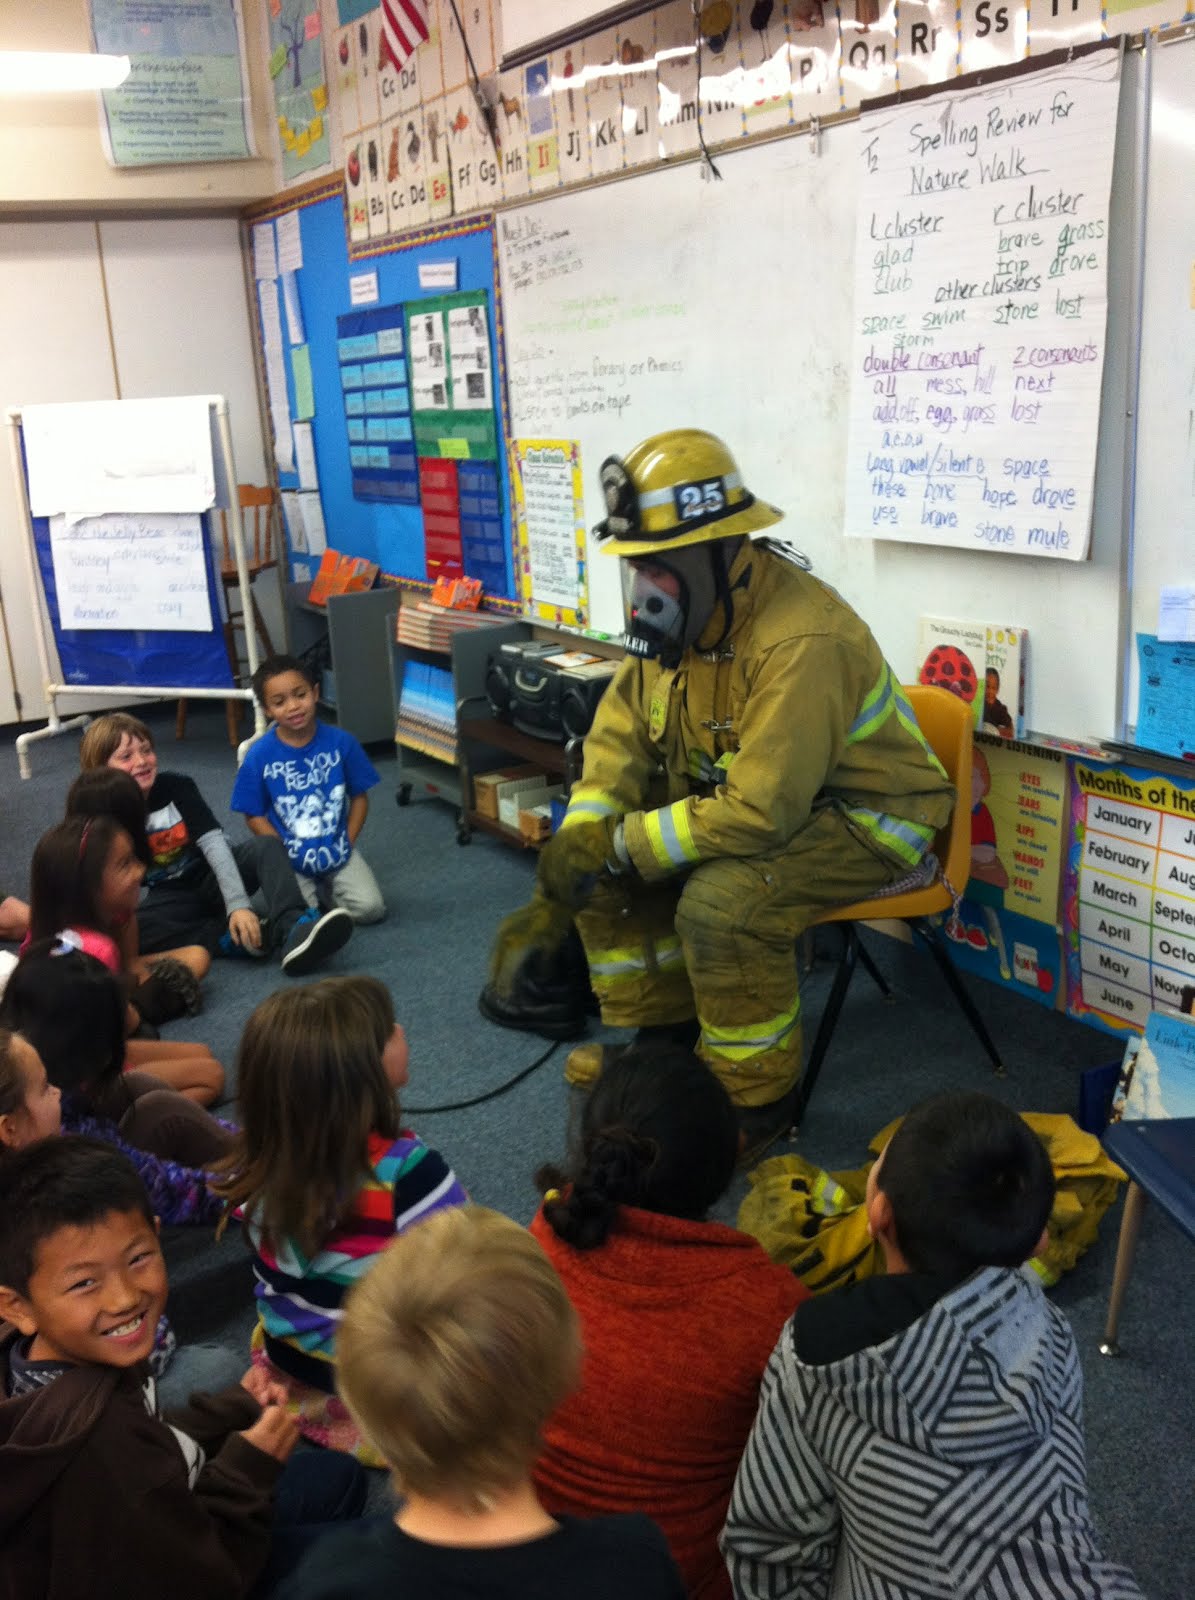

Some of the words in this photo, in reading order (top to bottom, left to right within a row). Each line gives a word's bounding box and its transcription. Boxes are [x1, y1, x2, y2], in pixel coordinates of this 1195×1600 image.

[975, 1, 1009, 38] Ss
[382, 77, 396, 99] Cc
[401, 63, 417, 90] Dd
[907, 119, 979, 158] Spelling
[985, 106, 1042, 139] Review
[1049, 90, 1075, 125] for
[370, 195, 384, 217] Bb
[391, 190, 405, 210] Cc
[409, 180, 426, 206] Dd
[432, 179, 447, 201] Ee
[458, 163, 471, 189] Ff
[479, 159, 497, 186] Gg
[505, 149, 523, 174] Hh
[537, 143, 550, 169] Ii
[566, 130, 581, 162] Jj
[596, 117, 618, 148] Kk
[635, 105, 649, 136] Ll
[910, 165, 970, 195] Nature
[979, 146, 1032, 186] Walk
[1014, 185, 1084, 219] cluster
[884, 209, 945, 240] cluster
[997, 229, 1044, 251] brave
[1058, 219, 1106, 256] grass
[996, 256, 1030, 280] trip
[1048, 250, 1099, 277] drove
[935, 278, 977, 301] other
[982, 273, 1042, 298] clusters
[861, 313, 907, 335] space
[921, 307, 967, 328] swim
[994, 298, 1039, 322] stone
[1055, 288, 1085, 317] lost
[863, 344, 909, 374] double
[1013, 346, 1025, 364] 2
[872, 374, 897, 397] all
[1014, 371, 1056, 393] next
[1010, 394, 1043, 424] lost
[1003, 457, 1051, 482] space
[679, 480, 726, 519] 25
[982, 477, 1018, 509] hope
[1032, 479, 1077, 508] drove
[872, 504, 898, 524] use
[921, 501, 959, 527] brave
[974, 521, 1016, 545] stone
[1027, 520, 1072, 550] mule
[263, 759, 298, 779] ARE
[304, 749, 341, 771] YOU
[285, 767, 331, 791] READY
[1078, 768, 1143, 801] Months
[1148, 787, 1166, 805] of
[1172, 790, 1195, 813] the
[1093, 805, 1152, 834] January
[1088, 841, 1150, 874] February
[1092, 880, 1138, 908] March
[1154, 901, 1195, 926] Septe
[1098, 919, 1131, 943] April
[1099, 954, 1130, 978] May
[1159, 940, 1195, 964] Octo
[1100, 988, 1135, 1011] June
